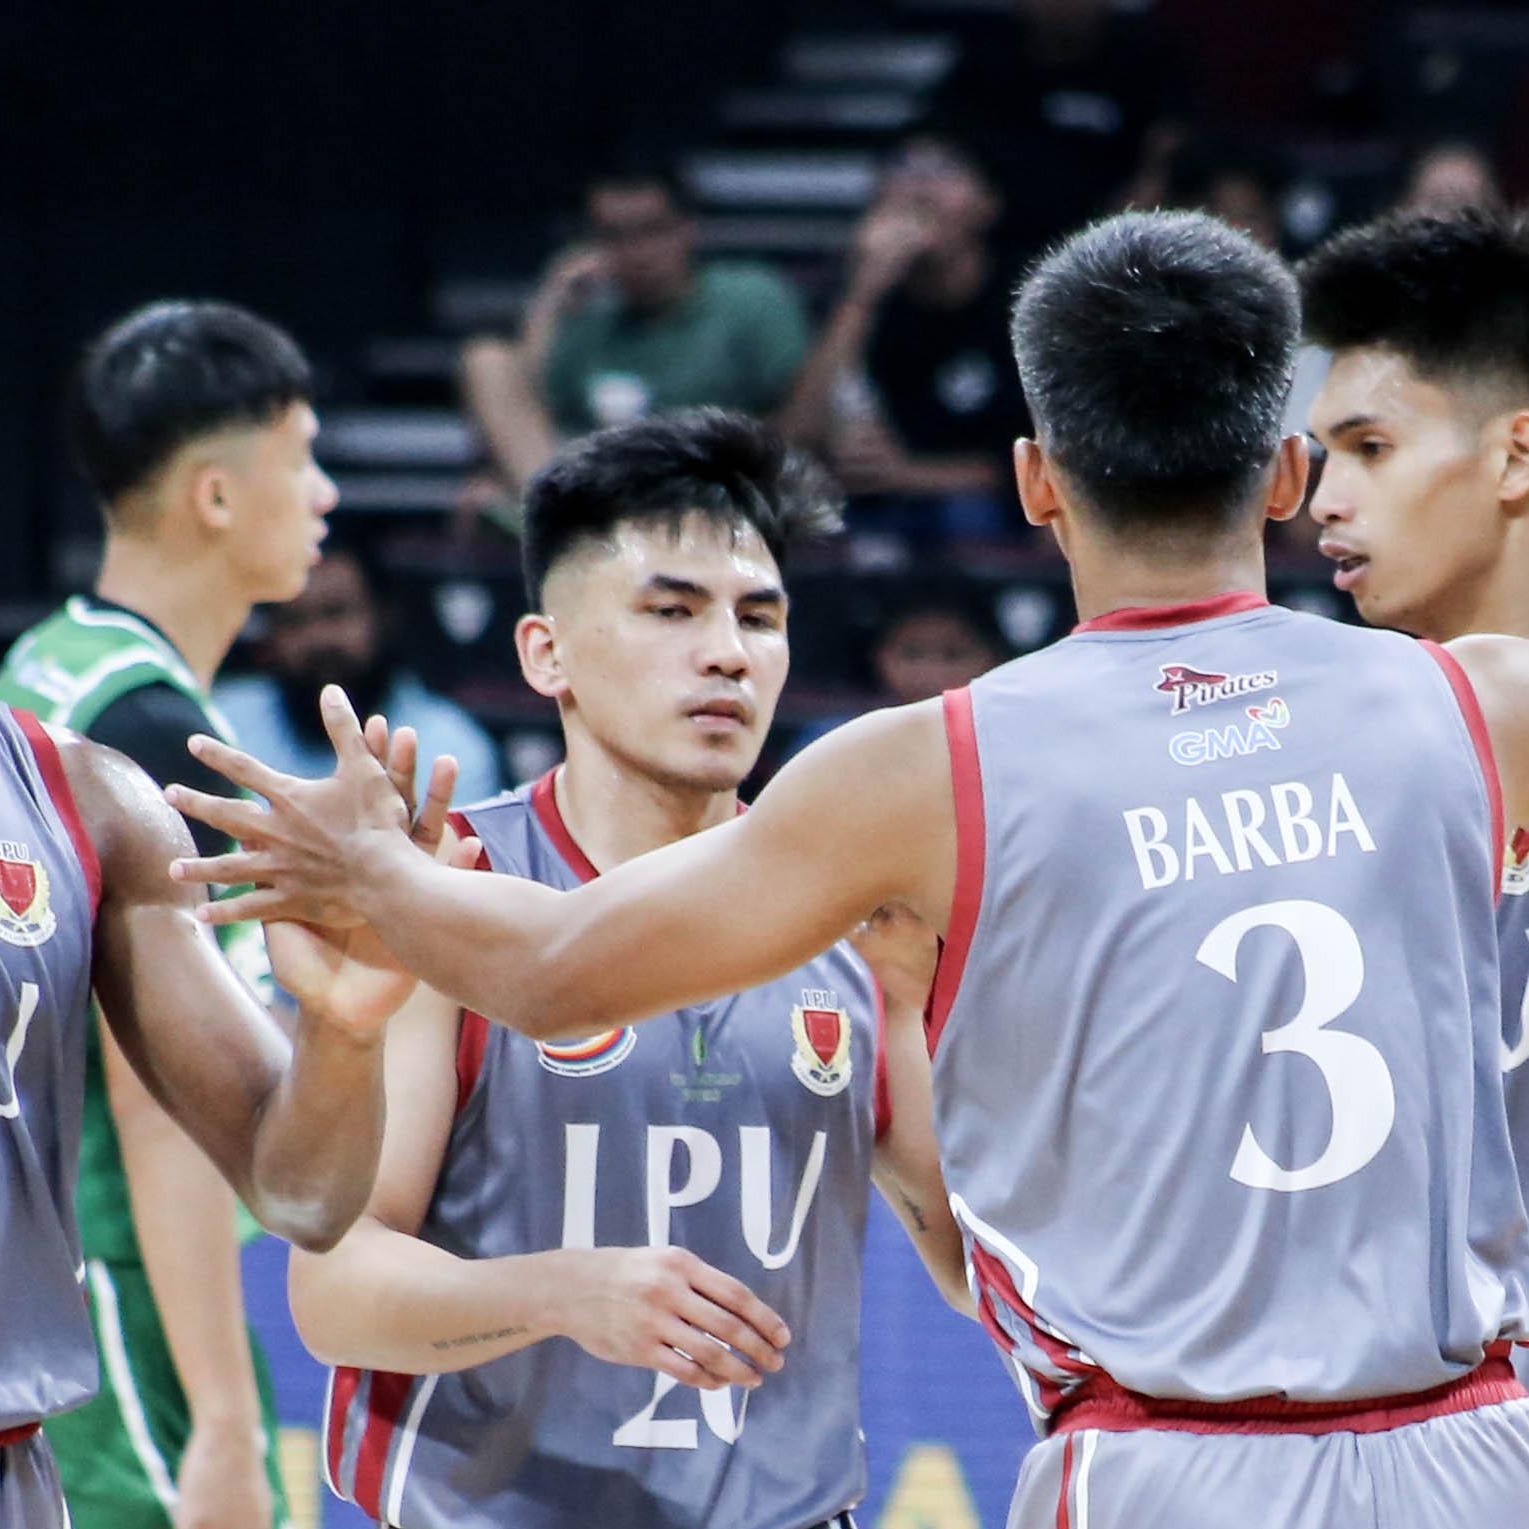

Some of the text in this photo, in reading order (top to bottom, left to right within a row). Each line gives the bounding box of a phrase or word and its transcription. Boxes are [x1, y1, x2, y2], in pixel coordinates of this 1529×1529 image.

[1174, 671, 1276, 710] Pirates
[1170, 720, 1281, 765] GMA
[1123, 772, 1377, 890] BARBA
[1195, 900, 1395, 1191] 3
